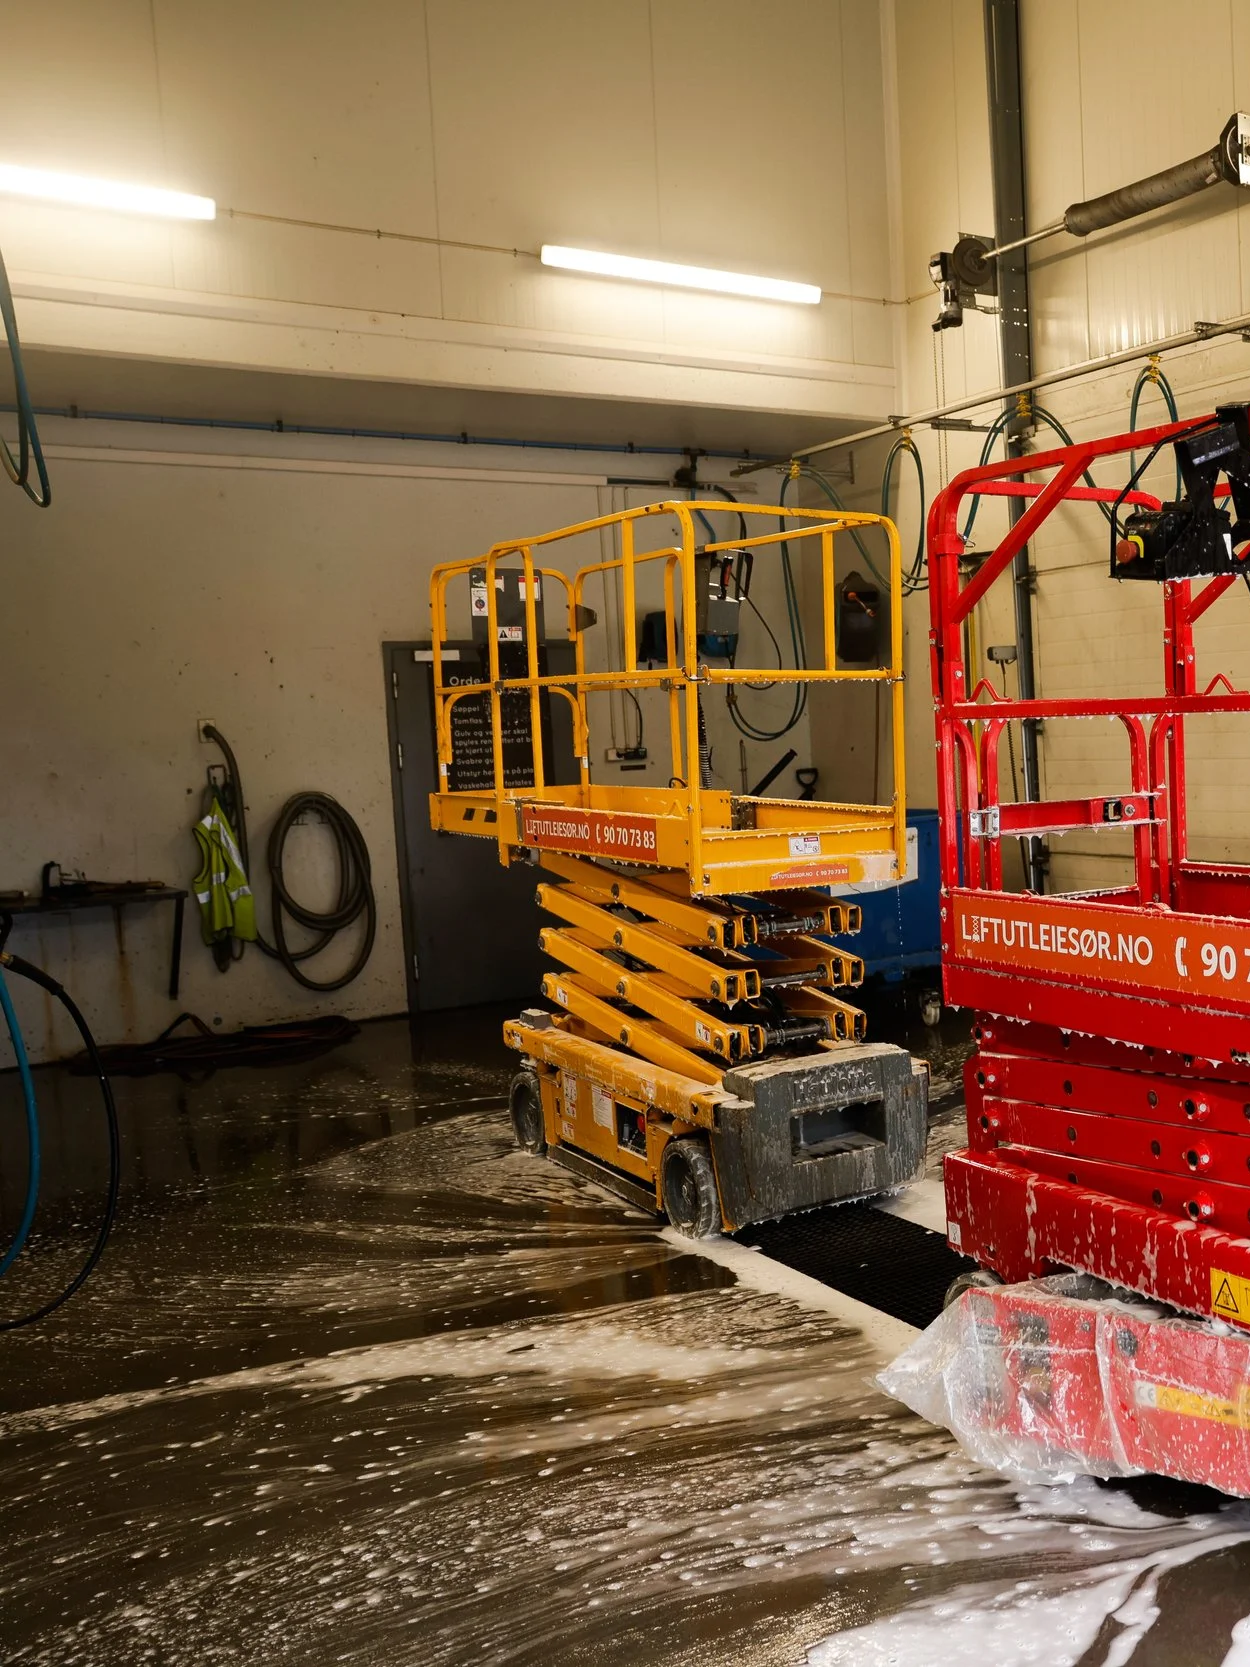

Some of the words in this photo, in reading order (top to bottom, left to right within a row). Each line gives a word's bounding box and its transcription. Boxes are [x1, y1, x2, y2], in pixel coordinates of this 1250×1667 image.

[449, 676, 482, 686] Orde
[453, 717, 483, 725] Tomflas
[604, 825, 615, 844] 90
[616, 827, 628, 846] 70
[630, 828, 641, 848] 73
[643, 830, 655, 849] 83
[1200, 943, 1237, 980] 90
